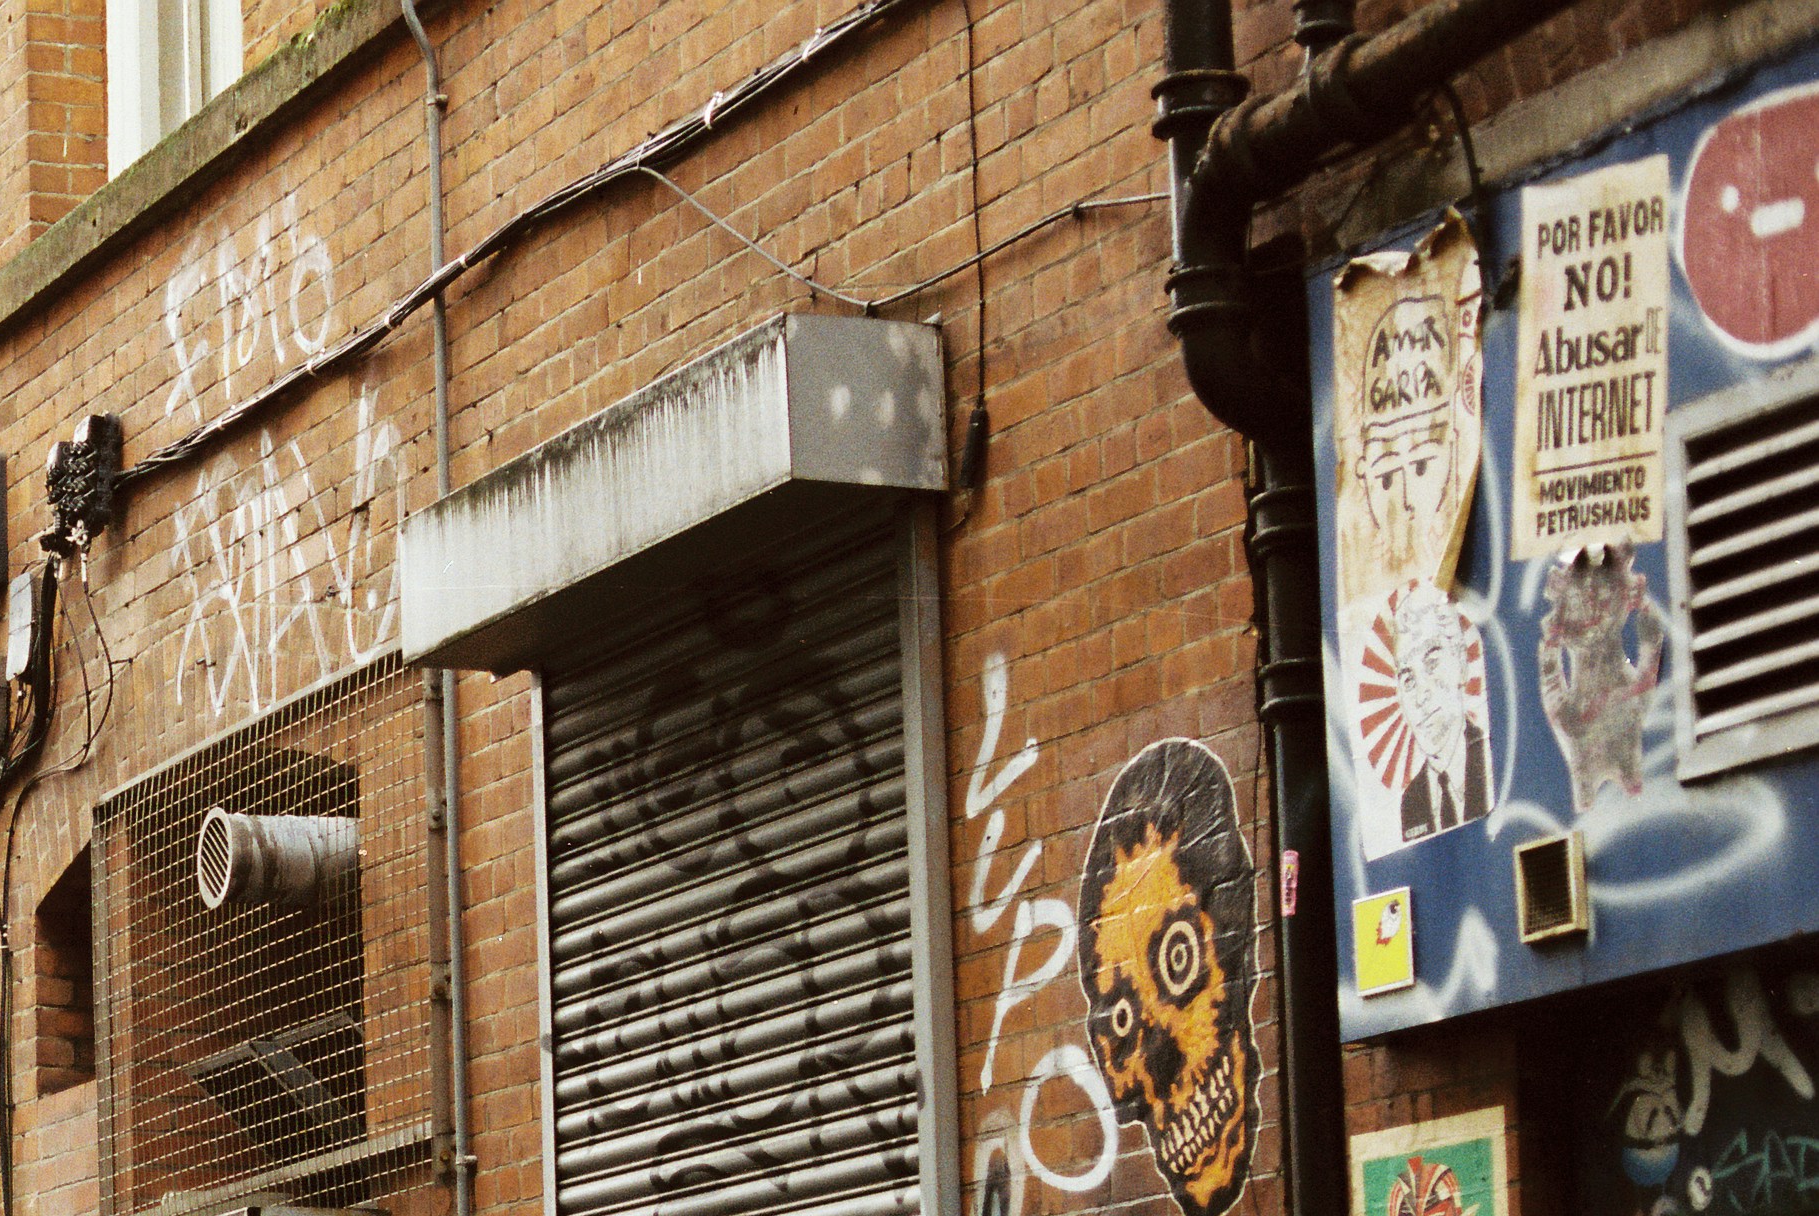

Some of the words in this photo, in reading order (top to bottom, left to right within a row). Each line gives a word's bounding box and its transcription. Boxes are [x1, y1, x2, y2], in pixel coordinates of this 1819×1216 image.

[1538, 214, 1580, 259] POR
[1589, 194, 1664, 248] FAVOR
[1564, 252, 1632, 312] NO!
[1534, 324, 1644, 379] Abusar
[1537, 370, 1655, 451] INTERNET
[1539, 465, 1646, 505] MOVIMIENTO
[1536, 495, 1651, 537] PETRUSHAUS
